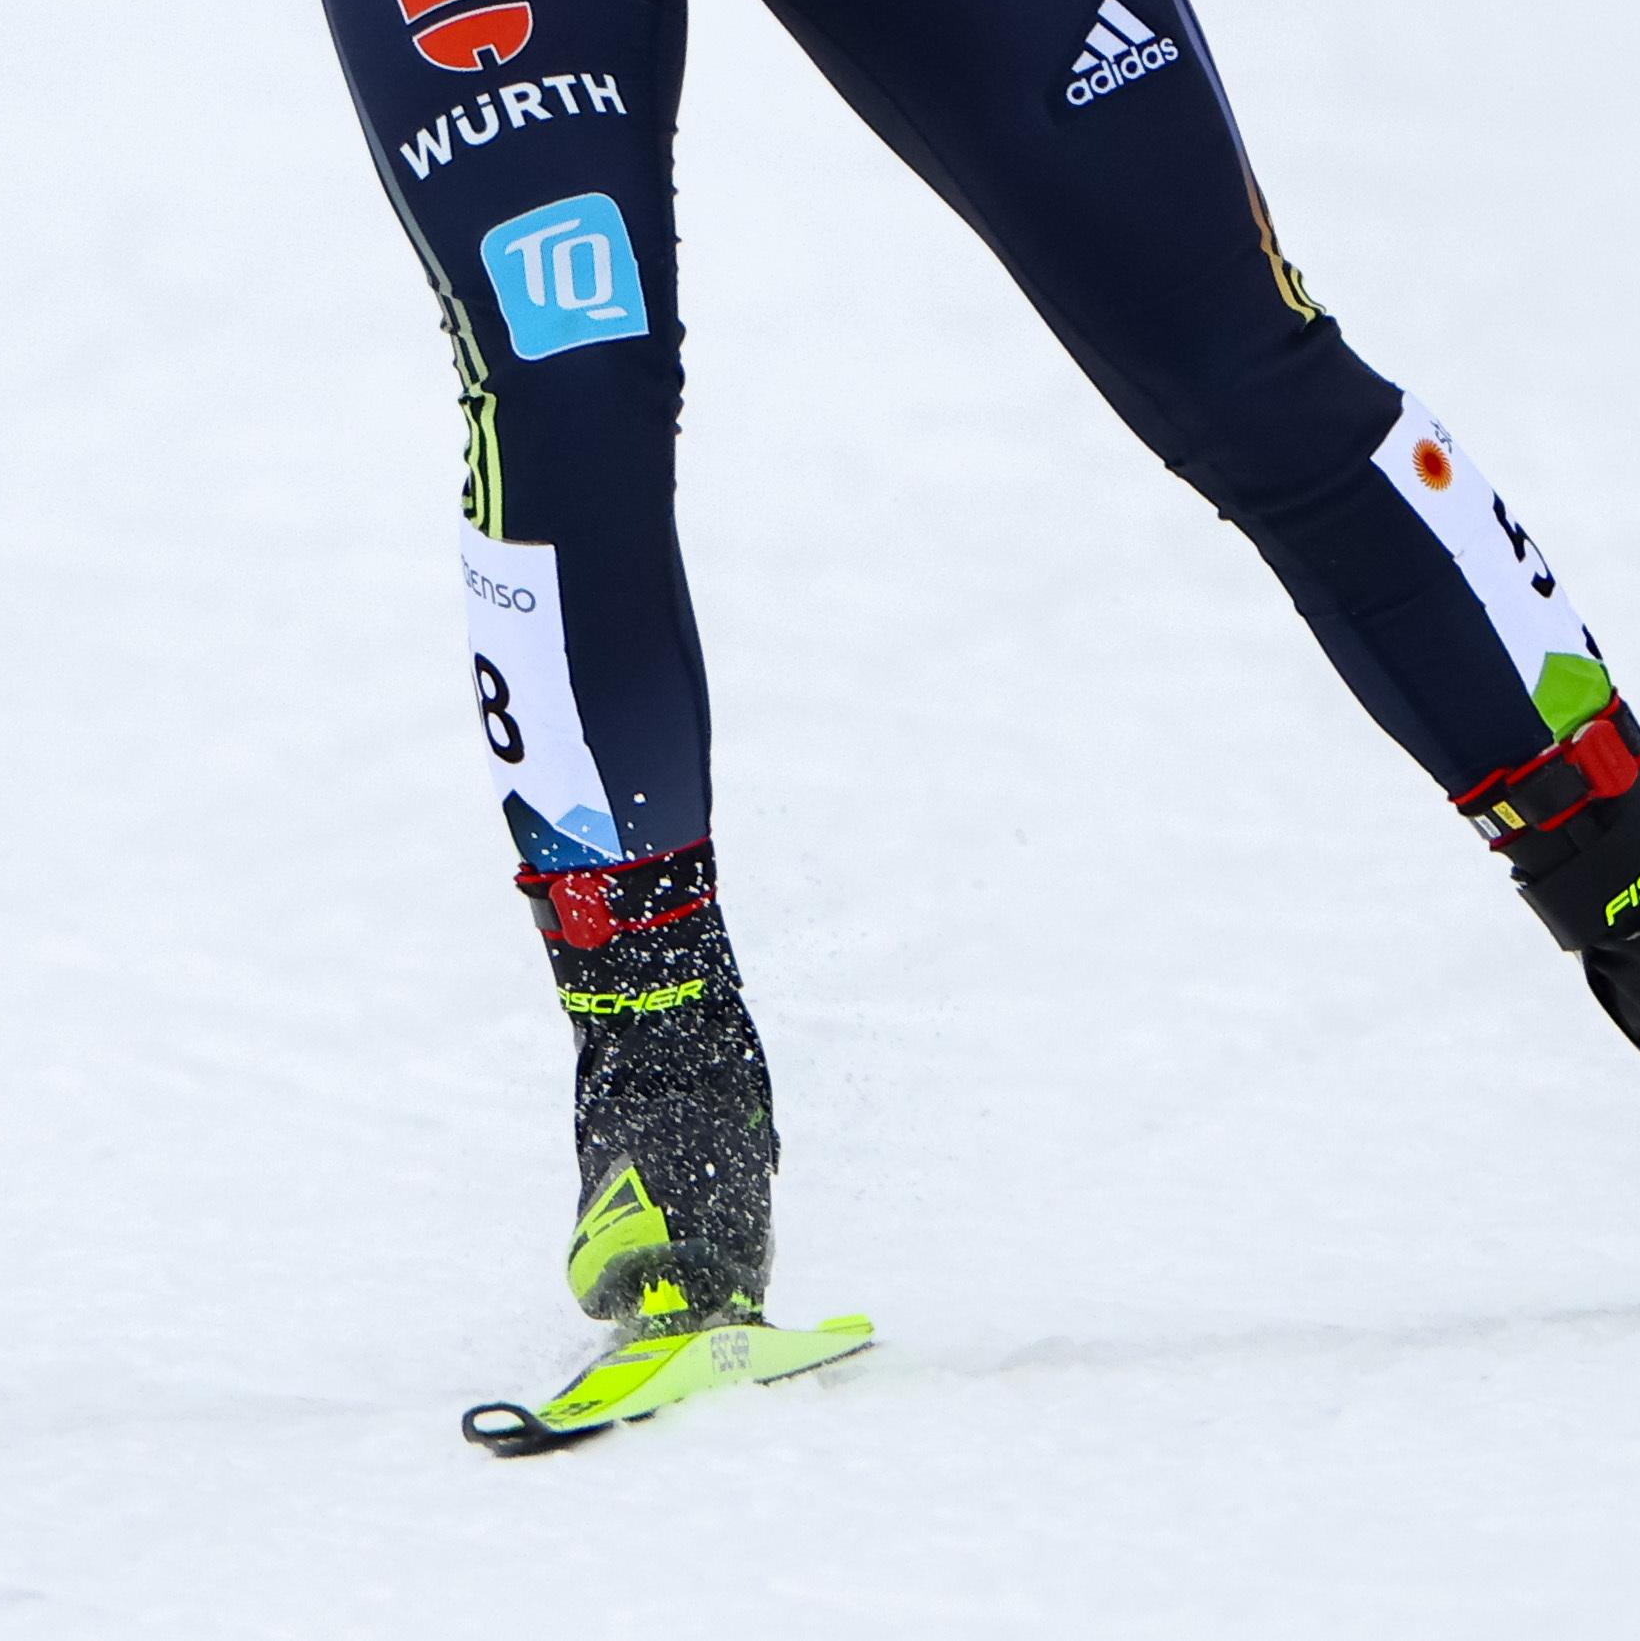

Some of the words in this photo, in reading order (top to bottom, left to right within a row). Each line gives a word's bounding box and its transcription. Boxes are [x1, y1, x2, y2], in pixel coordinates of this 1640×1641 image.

[1065, 37, 1179, 106] adidas
[399, 73, 628, 181] WÜRTH
[504, 218, 629, 321] TQ
